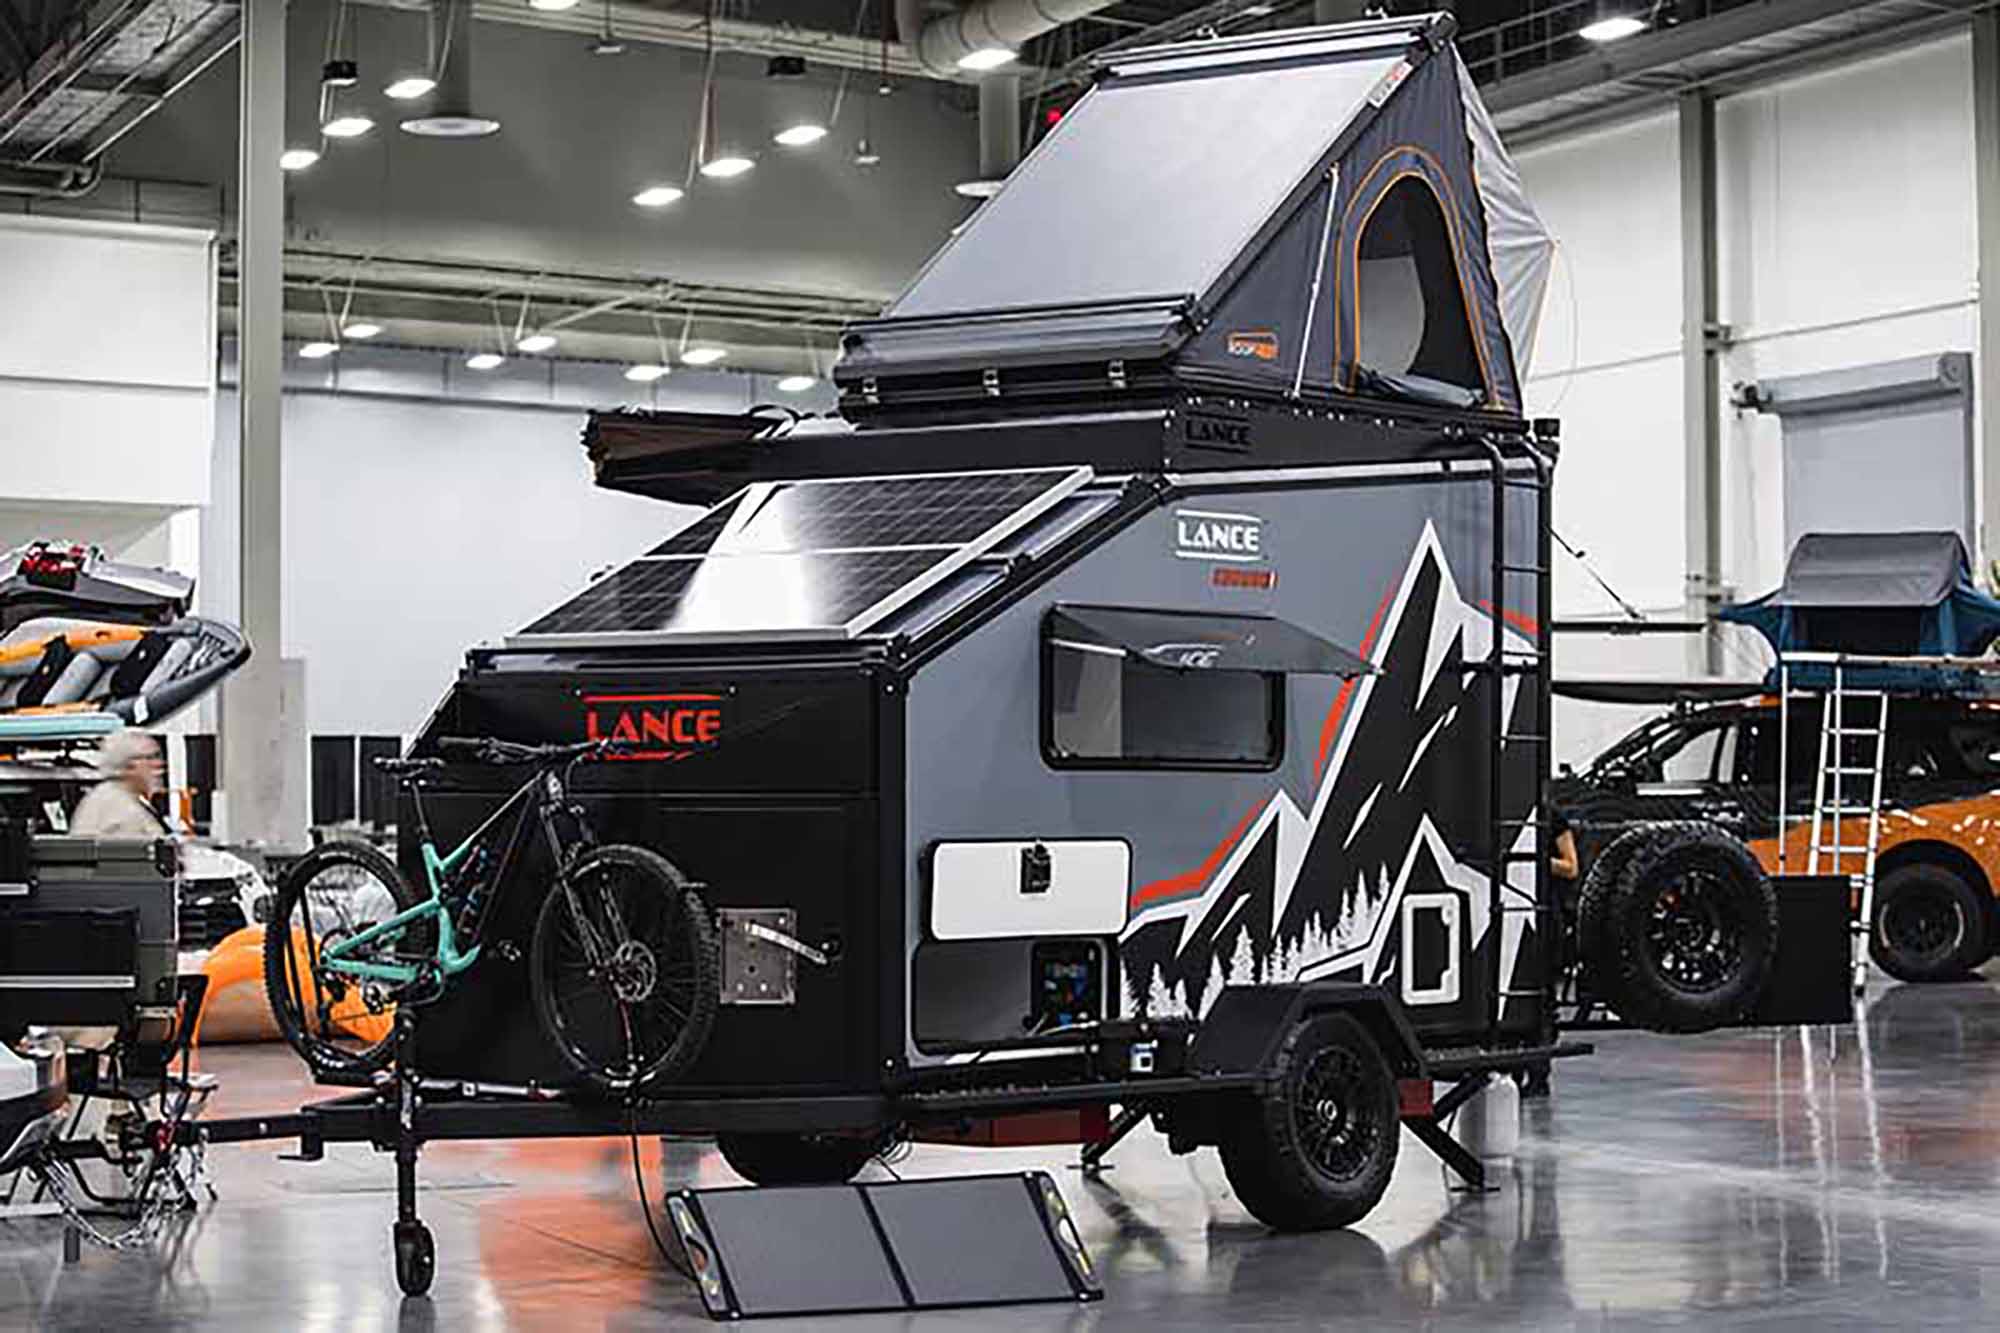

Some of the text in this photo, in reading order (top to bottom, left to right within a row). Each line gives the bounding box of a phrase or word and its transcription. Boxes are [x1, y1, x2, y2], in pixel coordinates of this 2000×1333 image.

[1186, 419, 1249, 444] LANCE
[1177, 520, 1260, 551] LANCE
[585, 708, 721, 744] LANCE
